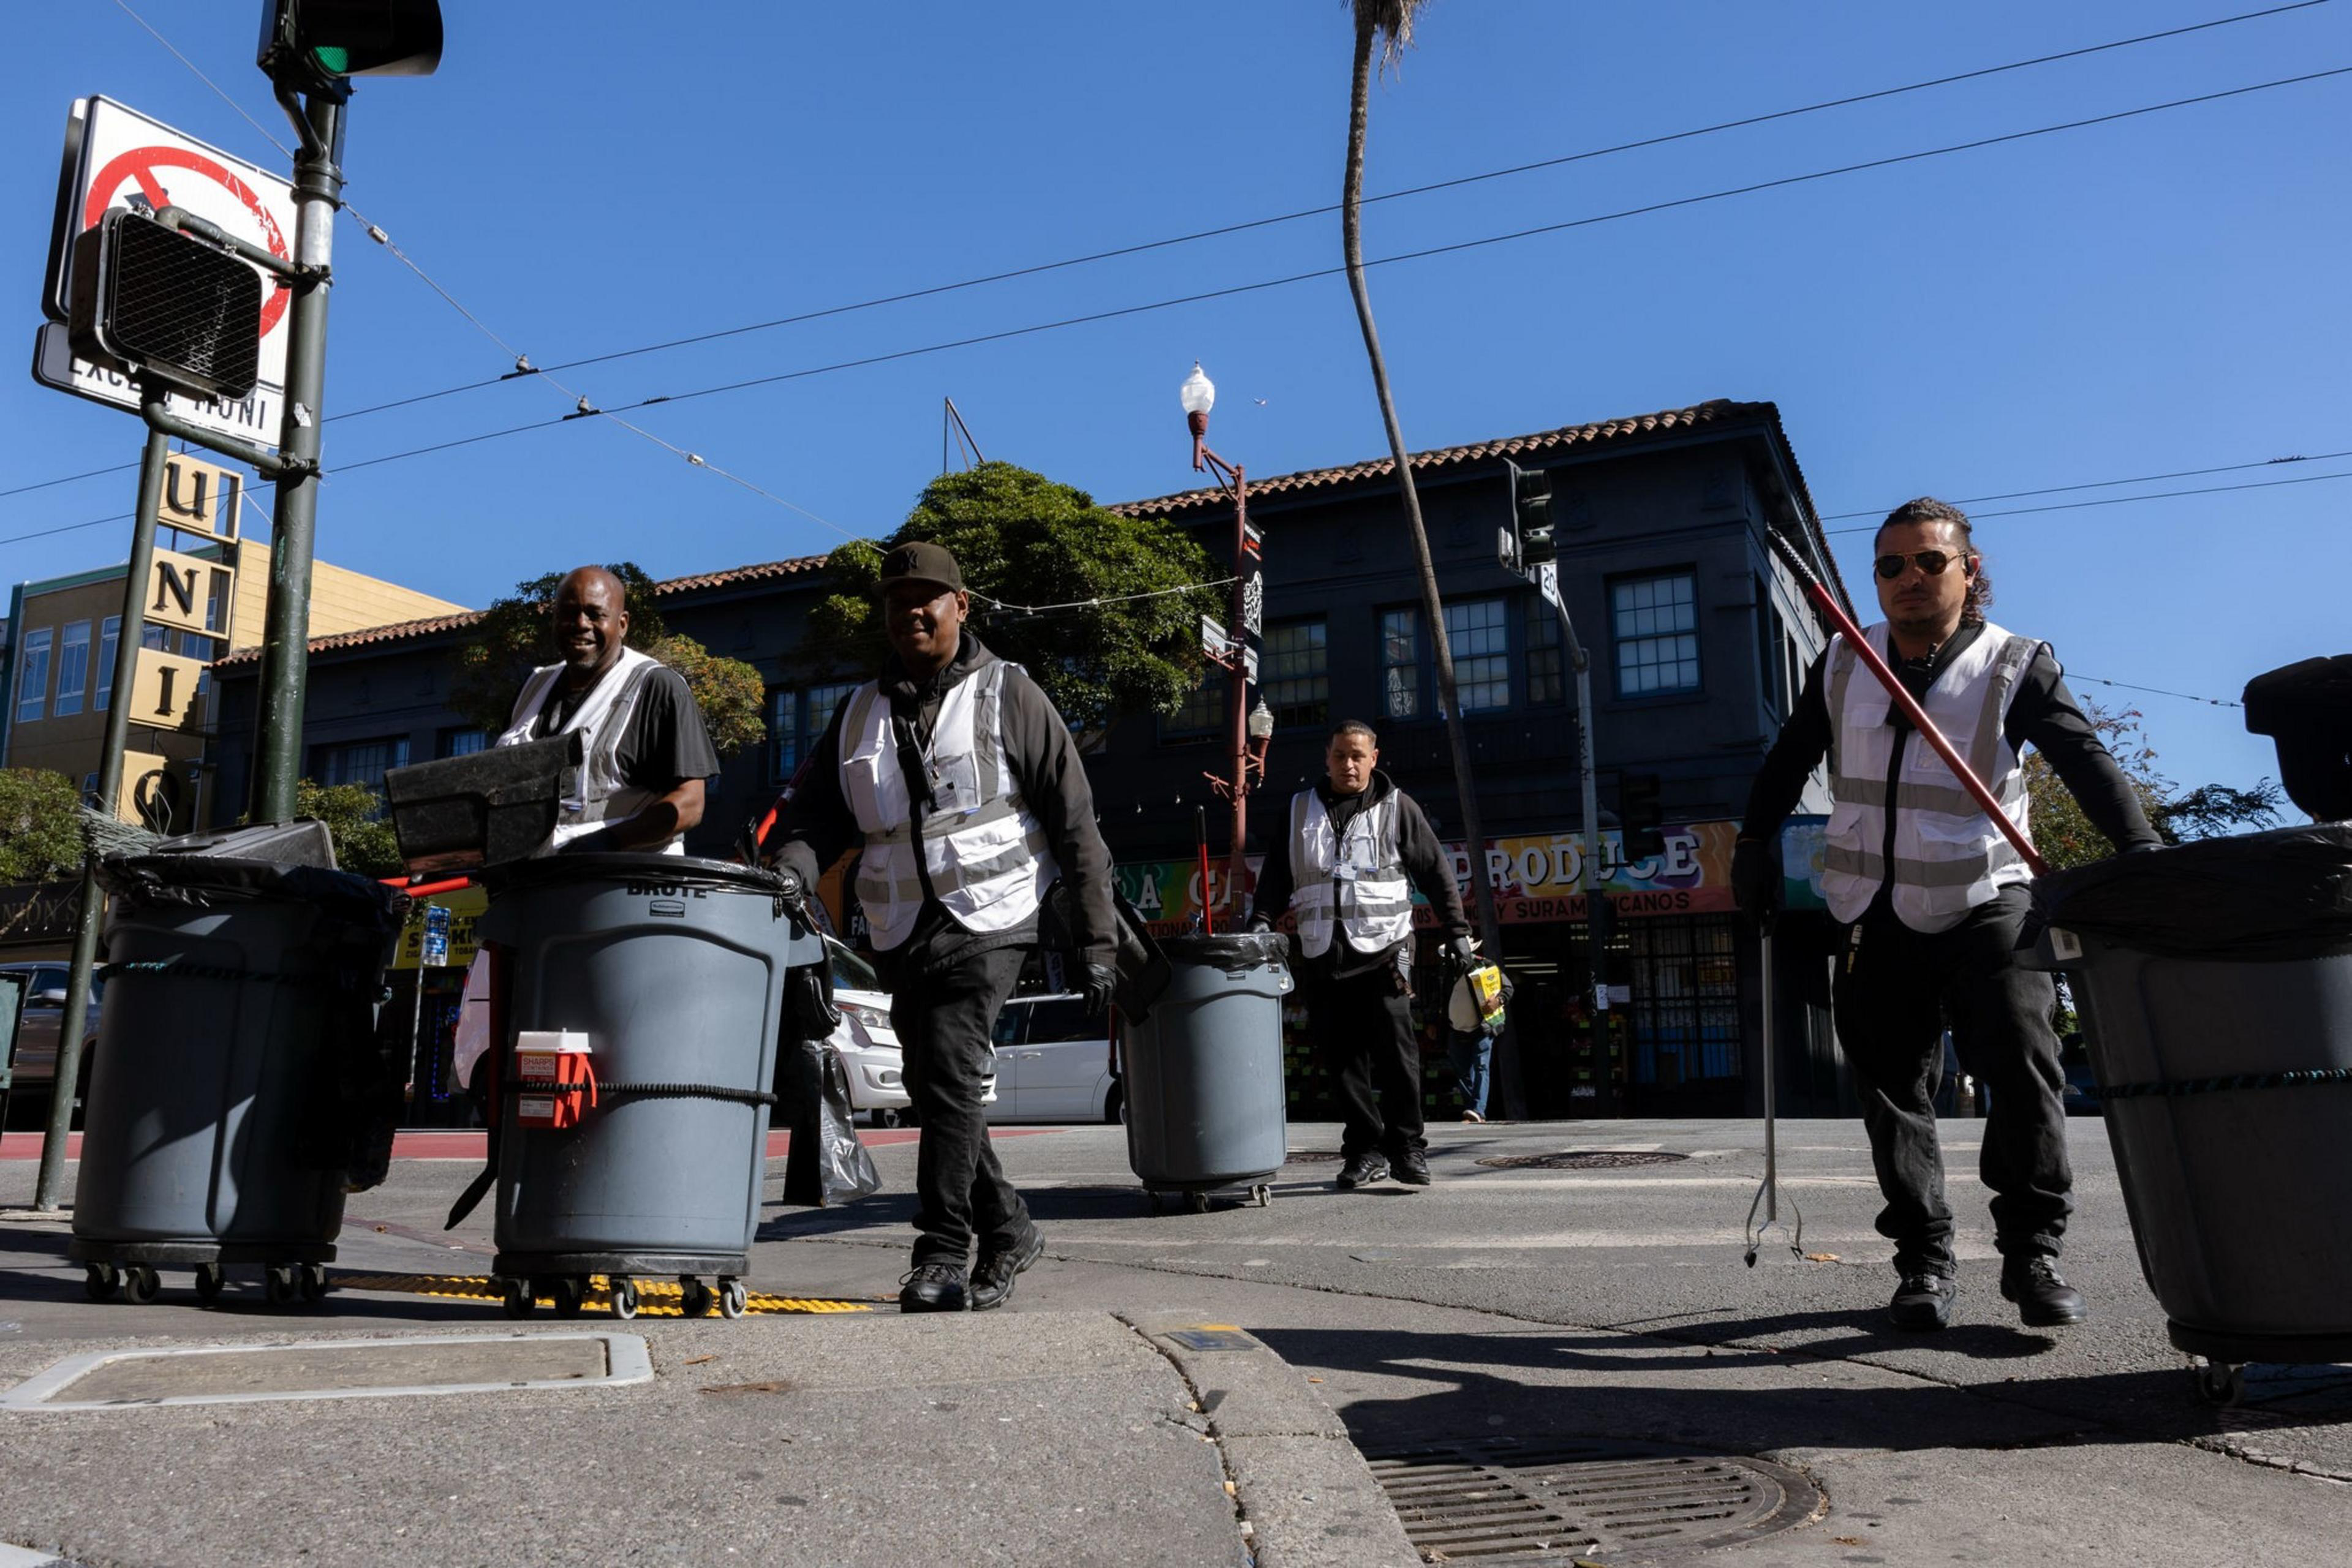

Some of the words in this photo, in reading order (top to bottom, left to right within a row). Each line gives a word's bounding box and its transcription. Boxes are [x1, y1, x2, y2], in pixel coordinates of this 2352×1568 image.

[1543, 567, 1555, 596] 20
[627, 883, 707, 899] BRUTE
[1516, 892, 1690, 918] SURAMICANOS
